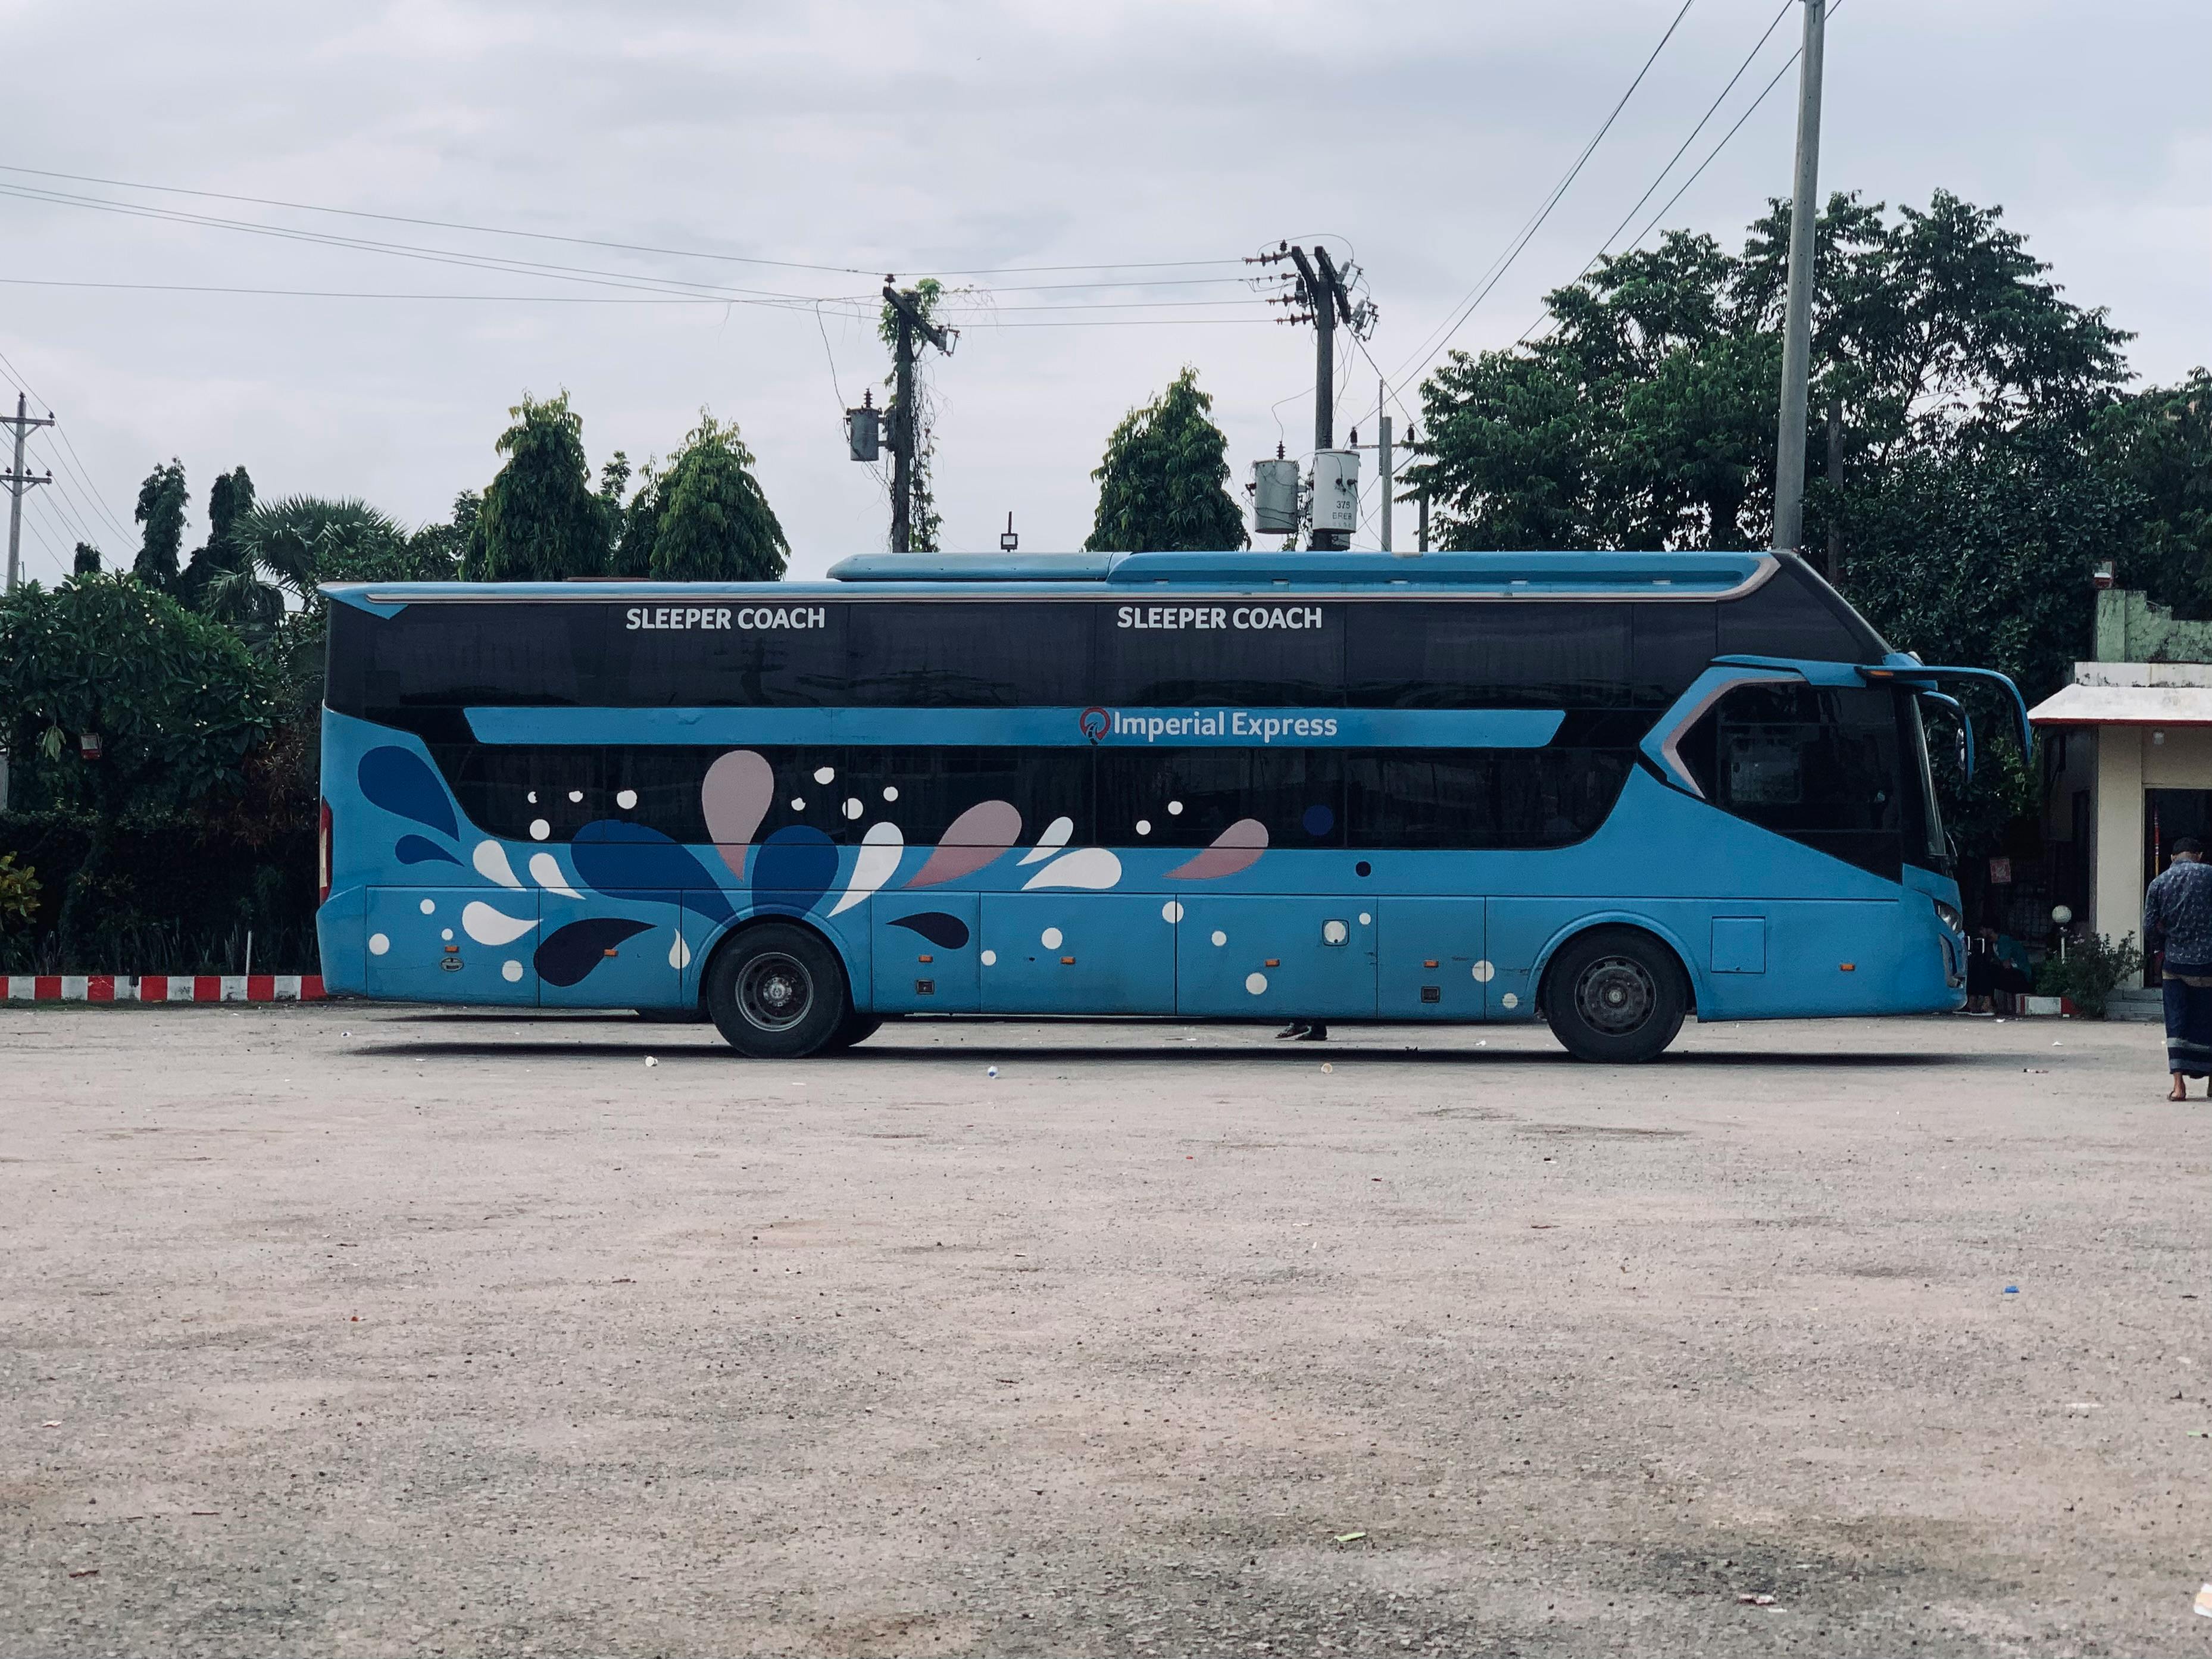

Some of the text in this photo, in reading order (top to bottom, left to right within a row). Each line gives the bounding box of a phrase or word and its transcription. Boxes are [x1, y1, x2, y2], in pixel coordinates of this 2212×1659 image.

[626, 607, 825, 629] SLEEPER COACH
[1117, 607, 1322, 629] SLEEPER COACH
[1114, 711, 1338, 743] Imperial Express
